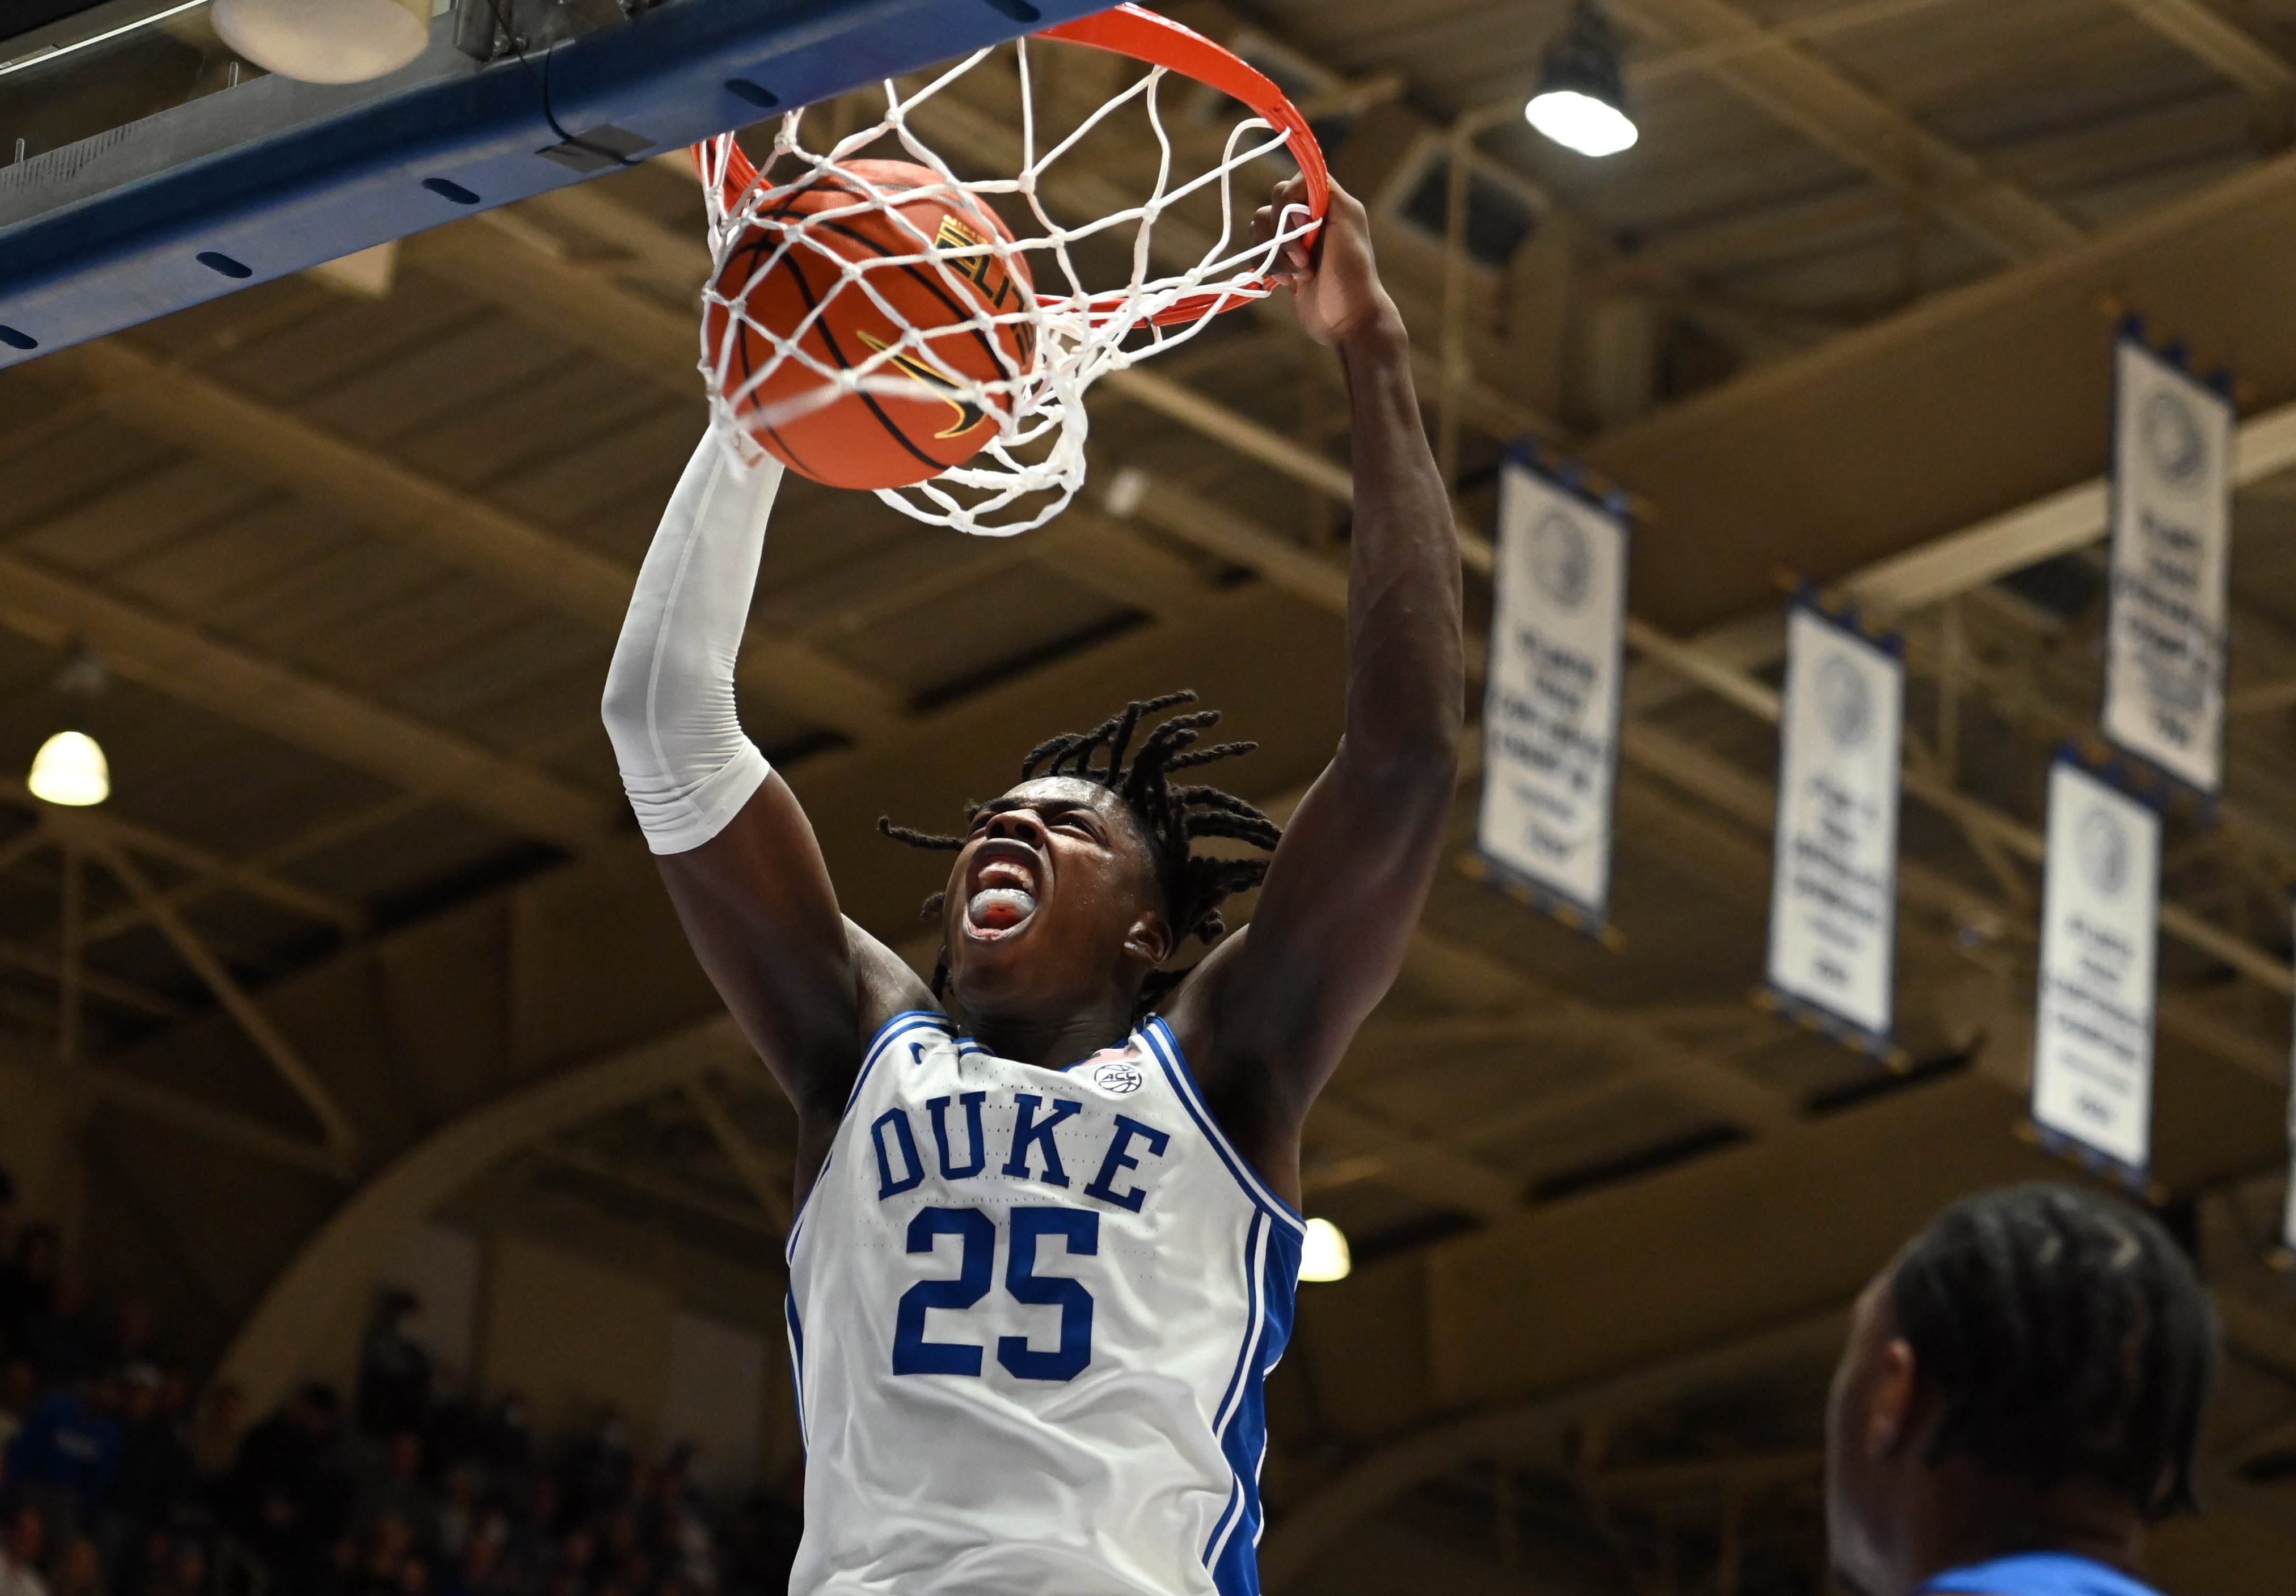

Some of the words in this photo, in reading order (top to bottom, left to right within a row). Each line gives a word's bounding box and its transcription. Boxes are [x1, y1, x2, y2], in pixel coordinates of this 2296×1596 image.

[1101, 1071, 1136, 1080] ACC
[872, 1091, 1170, 1213] DUKE
[893, 1207, 1099, 1381] 25
